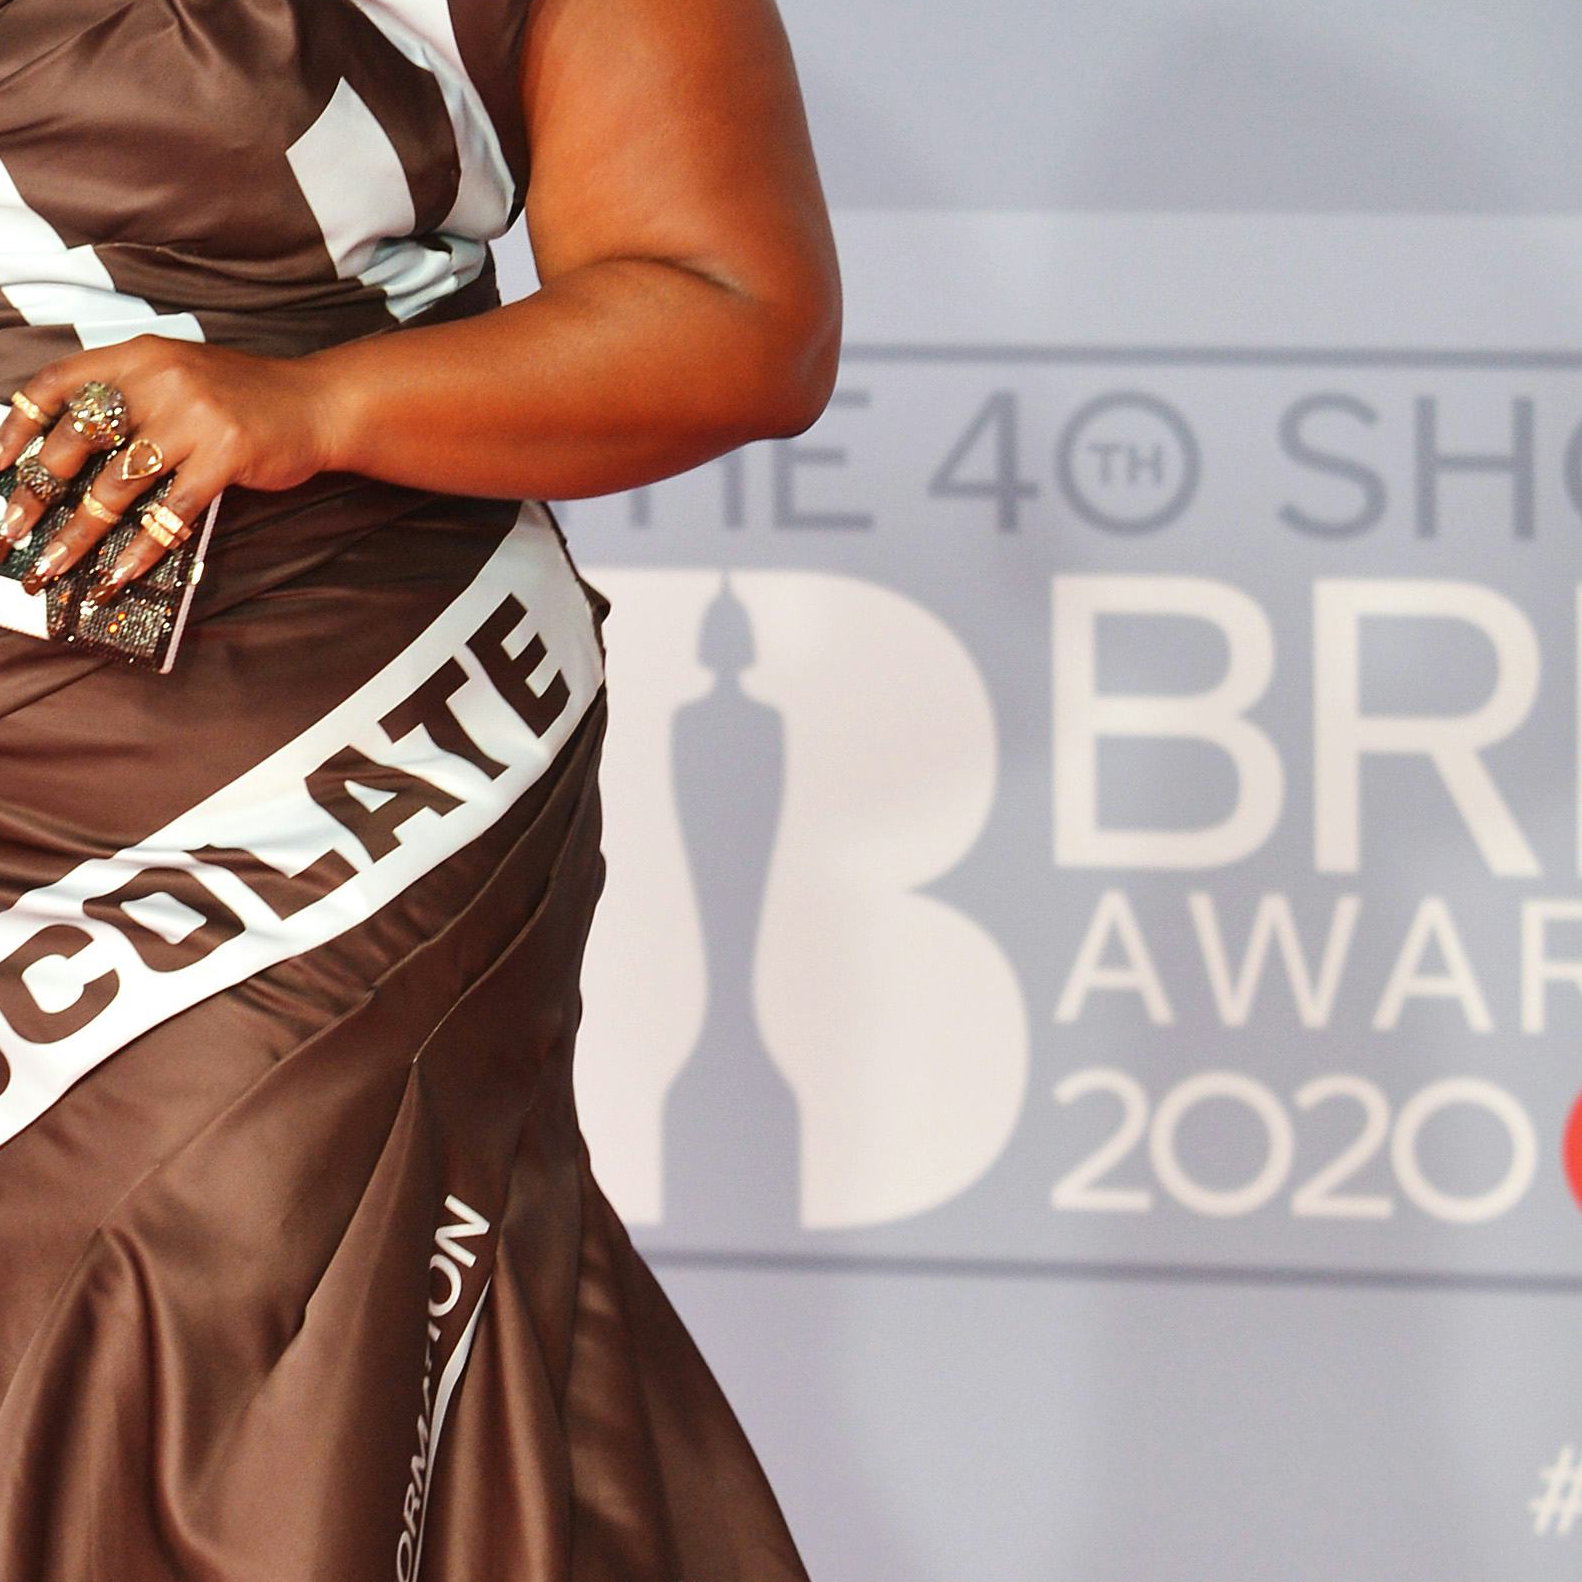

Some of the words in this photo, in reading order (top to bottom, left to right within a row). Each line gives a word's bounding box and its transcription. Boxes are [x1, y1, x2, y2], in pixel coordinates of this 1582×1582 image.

[926, 389, 1203, 537] 40
[1275, 391, 1582, 543] SH
[1049, 573, 1582, 879] BR
[1050, 1068, 1539, 1224] 2020
